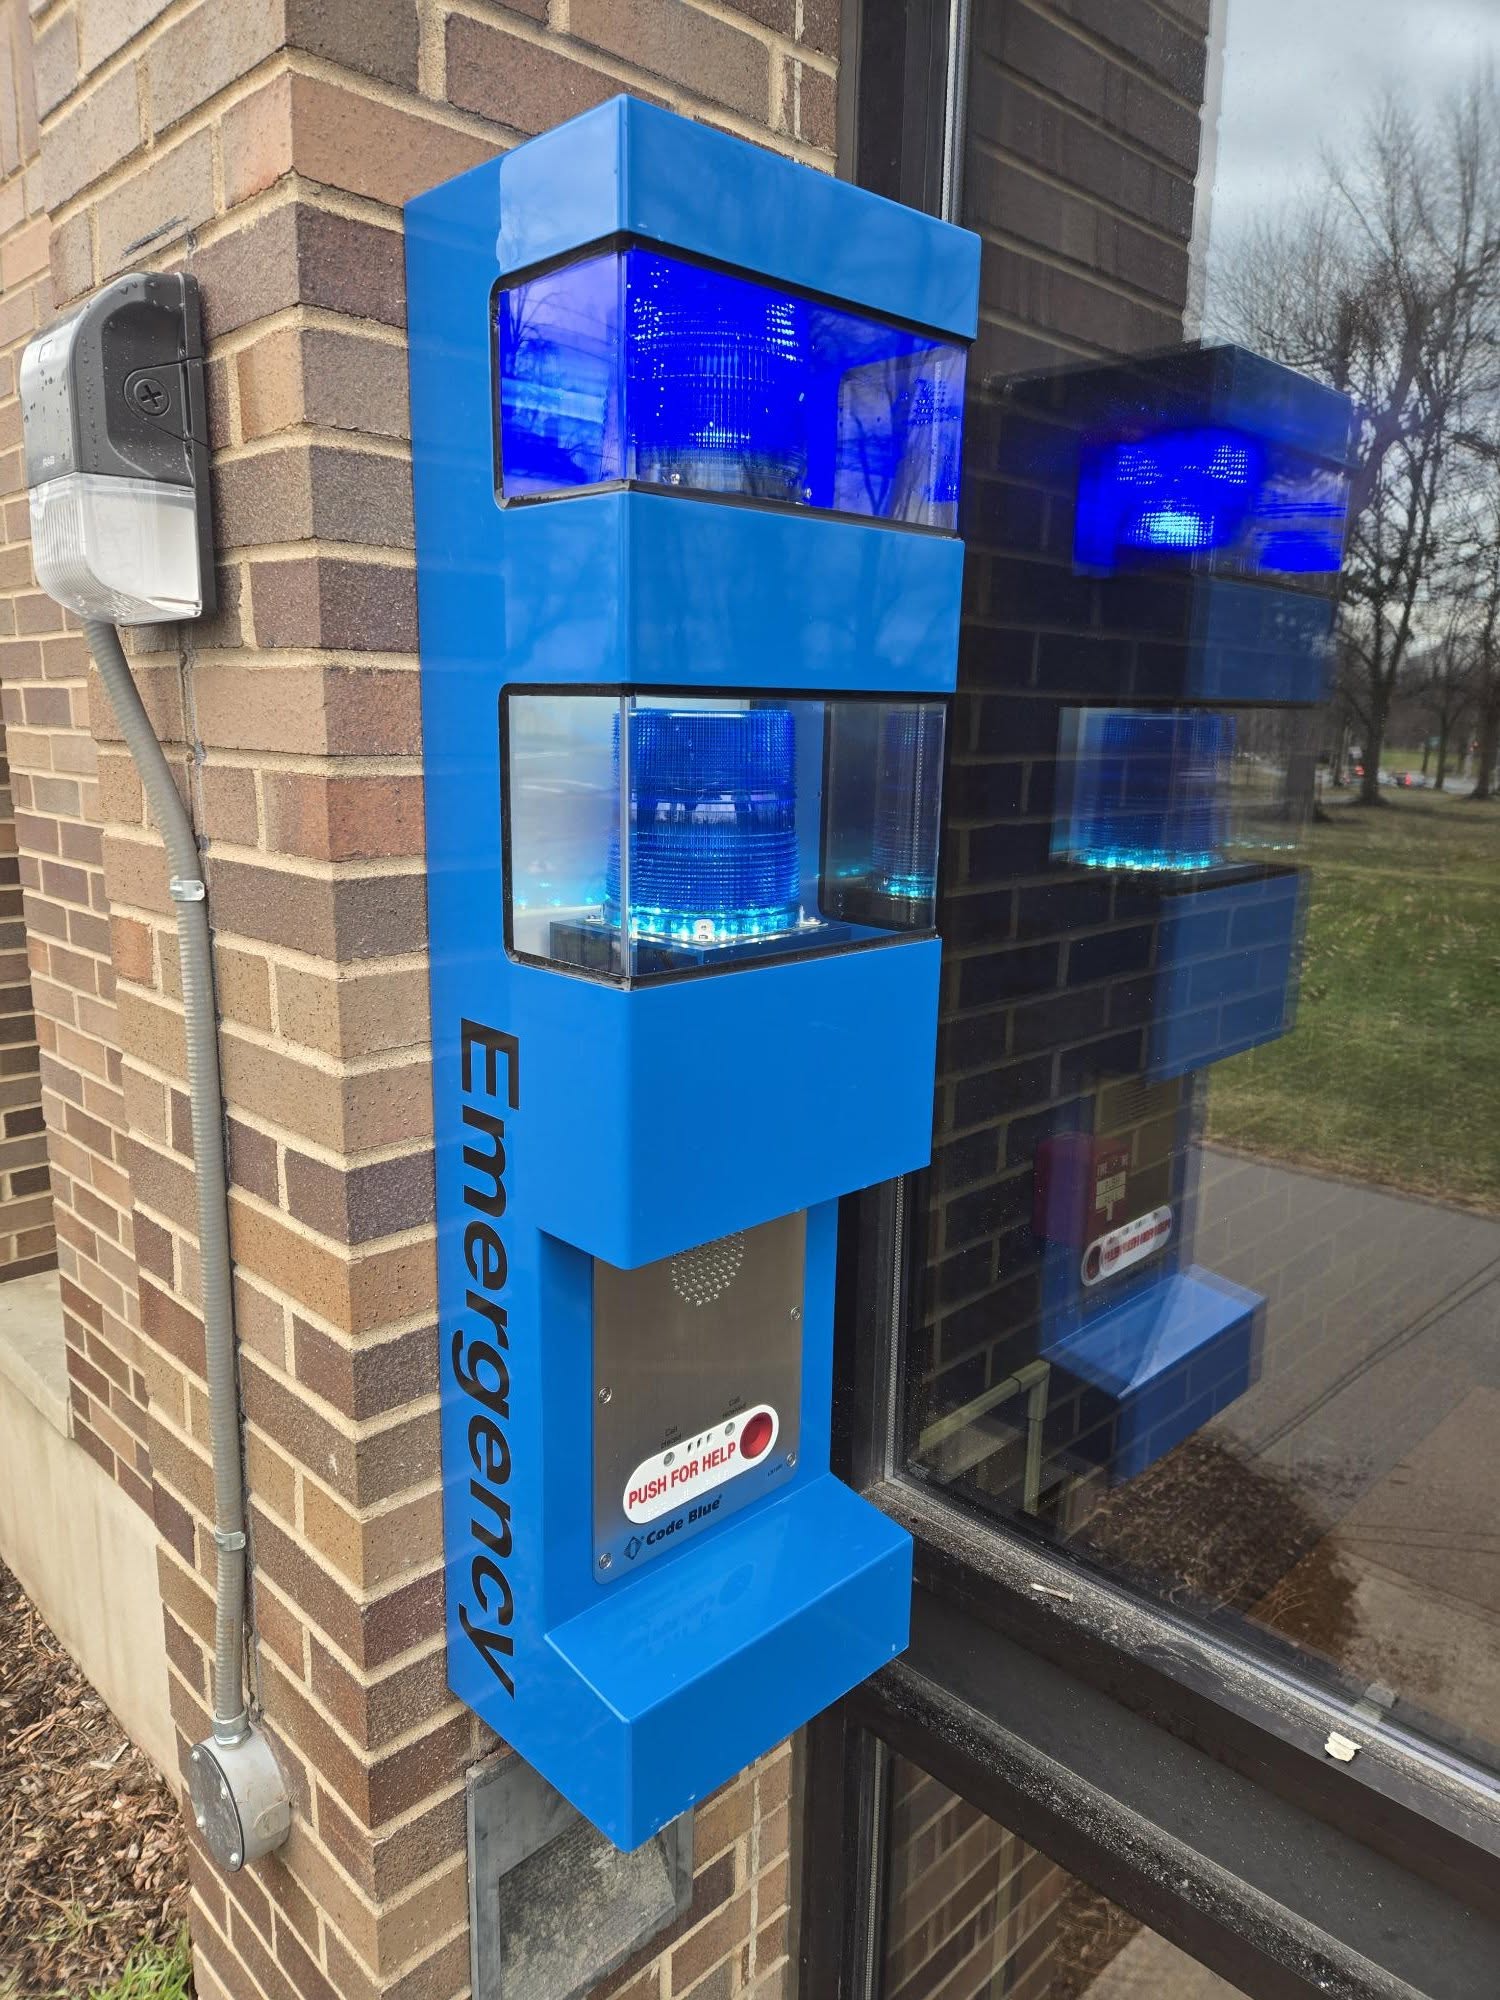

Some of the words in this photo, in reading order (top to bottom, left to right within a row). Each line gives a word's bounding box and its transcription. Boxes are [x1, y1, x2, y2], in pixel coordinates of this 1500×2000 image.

[452, 1017, 520, 1699] Emergency
[628, 1476, 668, 1510] PUSH
[671, 1460, 700, 1489] FOR
[702, 1442, 737, 1472] HELP
[646, 1518, 684, 1546] Code
[688, 1498, 720, 1528] Blue
